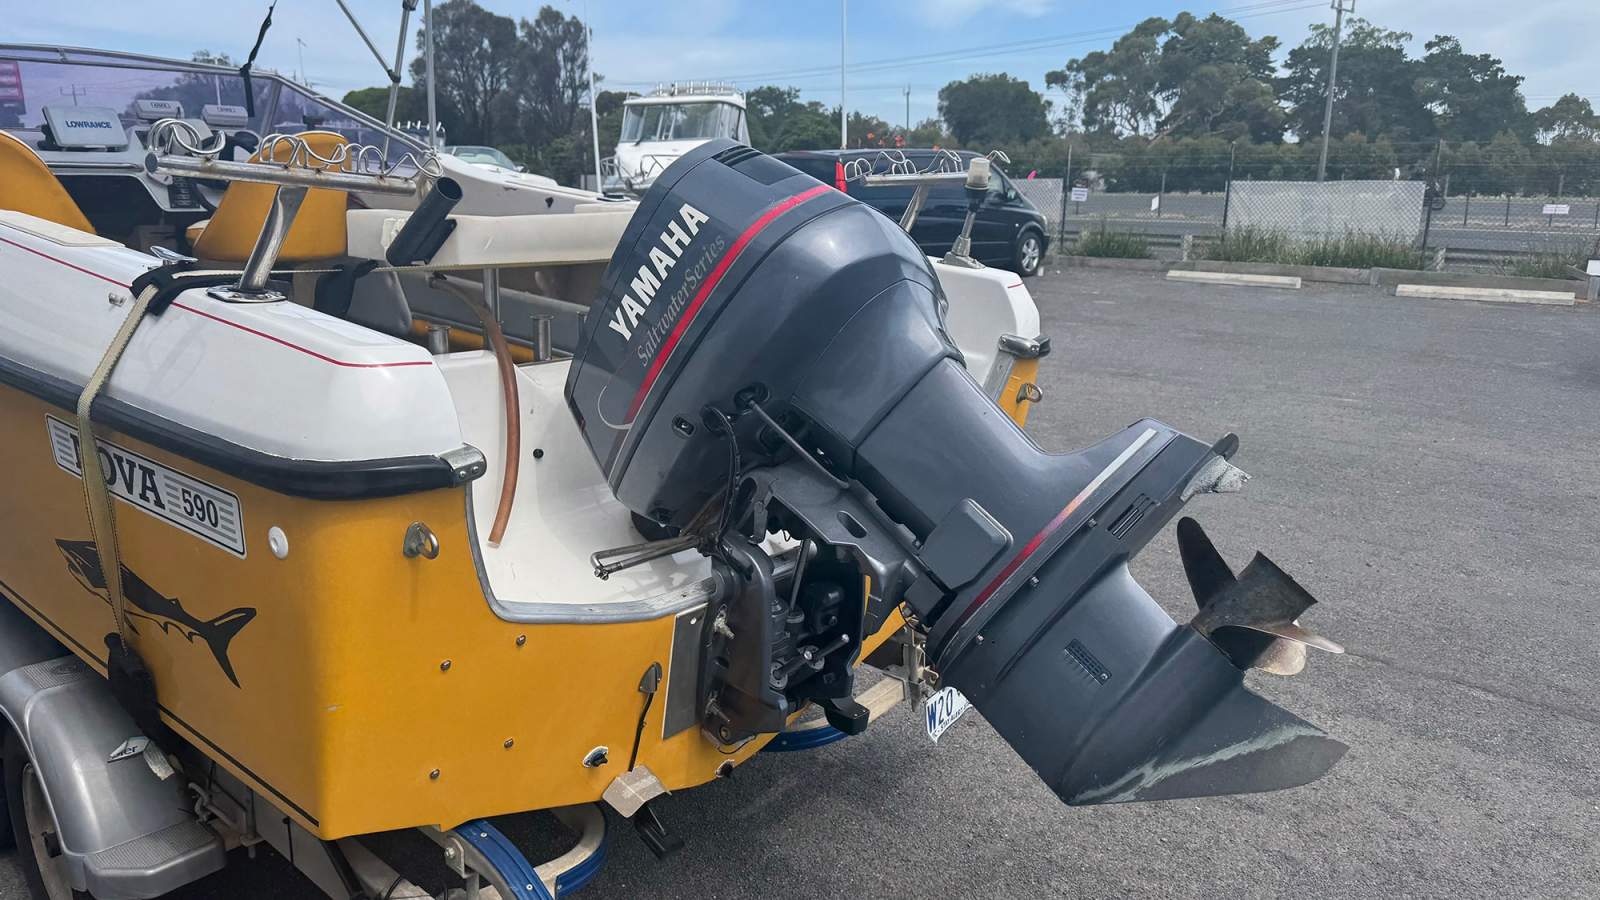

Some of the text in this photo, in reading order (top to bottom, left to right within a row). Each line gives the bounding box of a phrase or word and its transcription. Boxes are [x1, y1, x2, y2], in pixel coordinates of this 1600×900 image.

[65, 120, 112, 129] LOWRANCE
[608, 203, 710, 342] YAMAHA
[181, 488, 219, 528] 590
